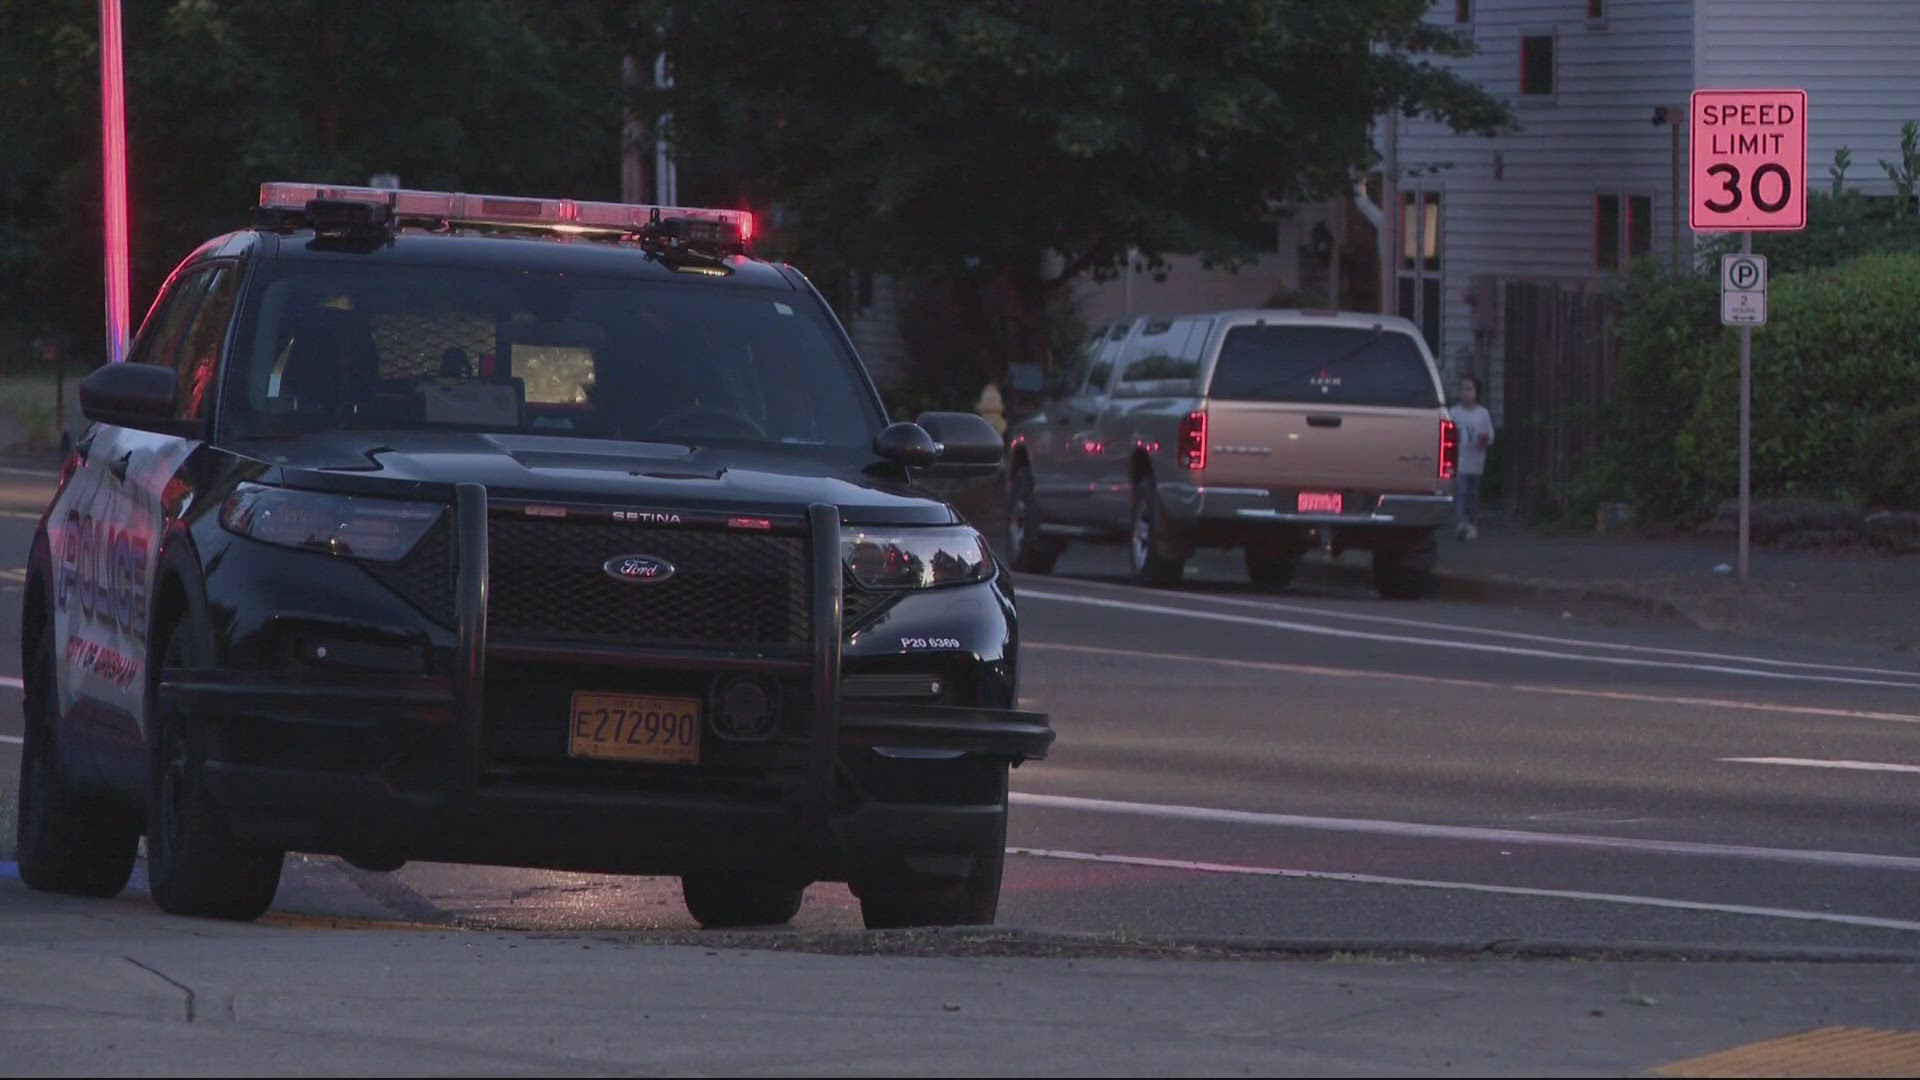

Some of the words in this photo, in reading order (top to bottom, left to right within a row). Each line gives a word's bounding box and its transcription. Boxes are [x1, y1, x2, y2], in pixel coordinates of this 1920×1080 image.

[1703, 104, 1794, 125] SPEED
[1712, 134, 1785, 154] LIMIT
[1704, 163, 1791, 213] 30
[1738, 265, 1753, 284] P
[1740, 295, 1748, 306] 2
[612, 511, 681, 524] SETINA
[59, 509, 148, 639] POLICE
[620, 557, 658, 577] Ford
[900, 637, 927, 648] P20
[928, 637, 960, 648] 6369
[576, 708, 694, 747] E272990
